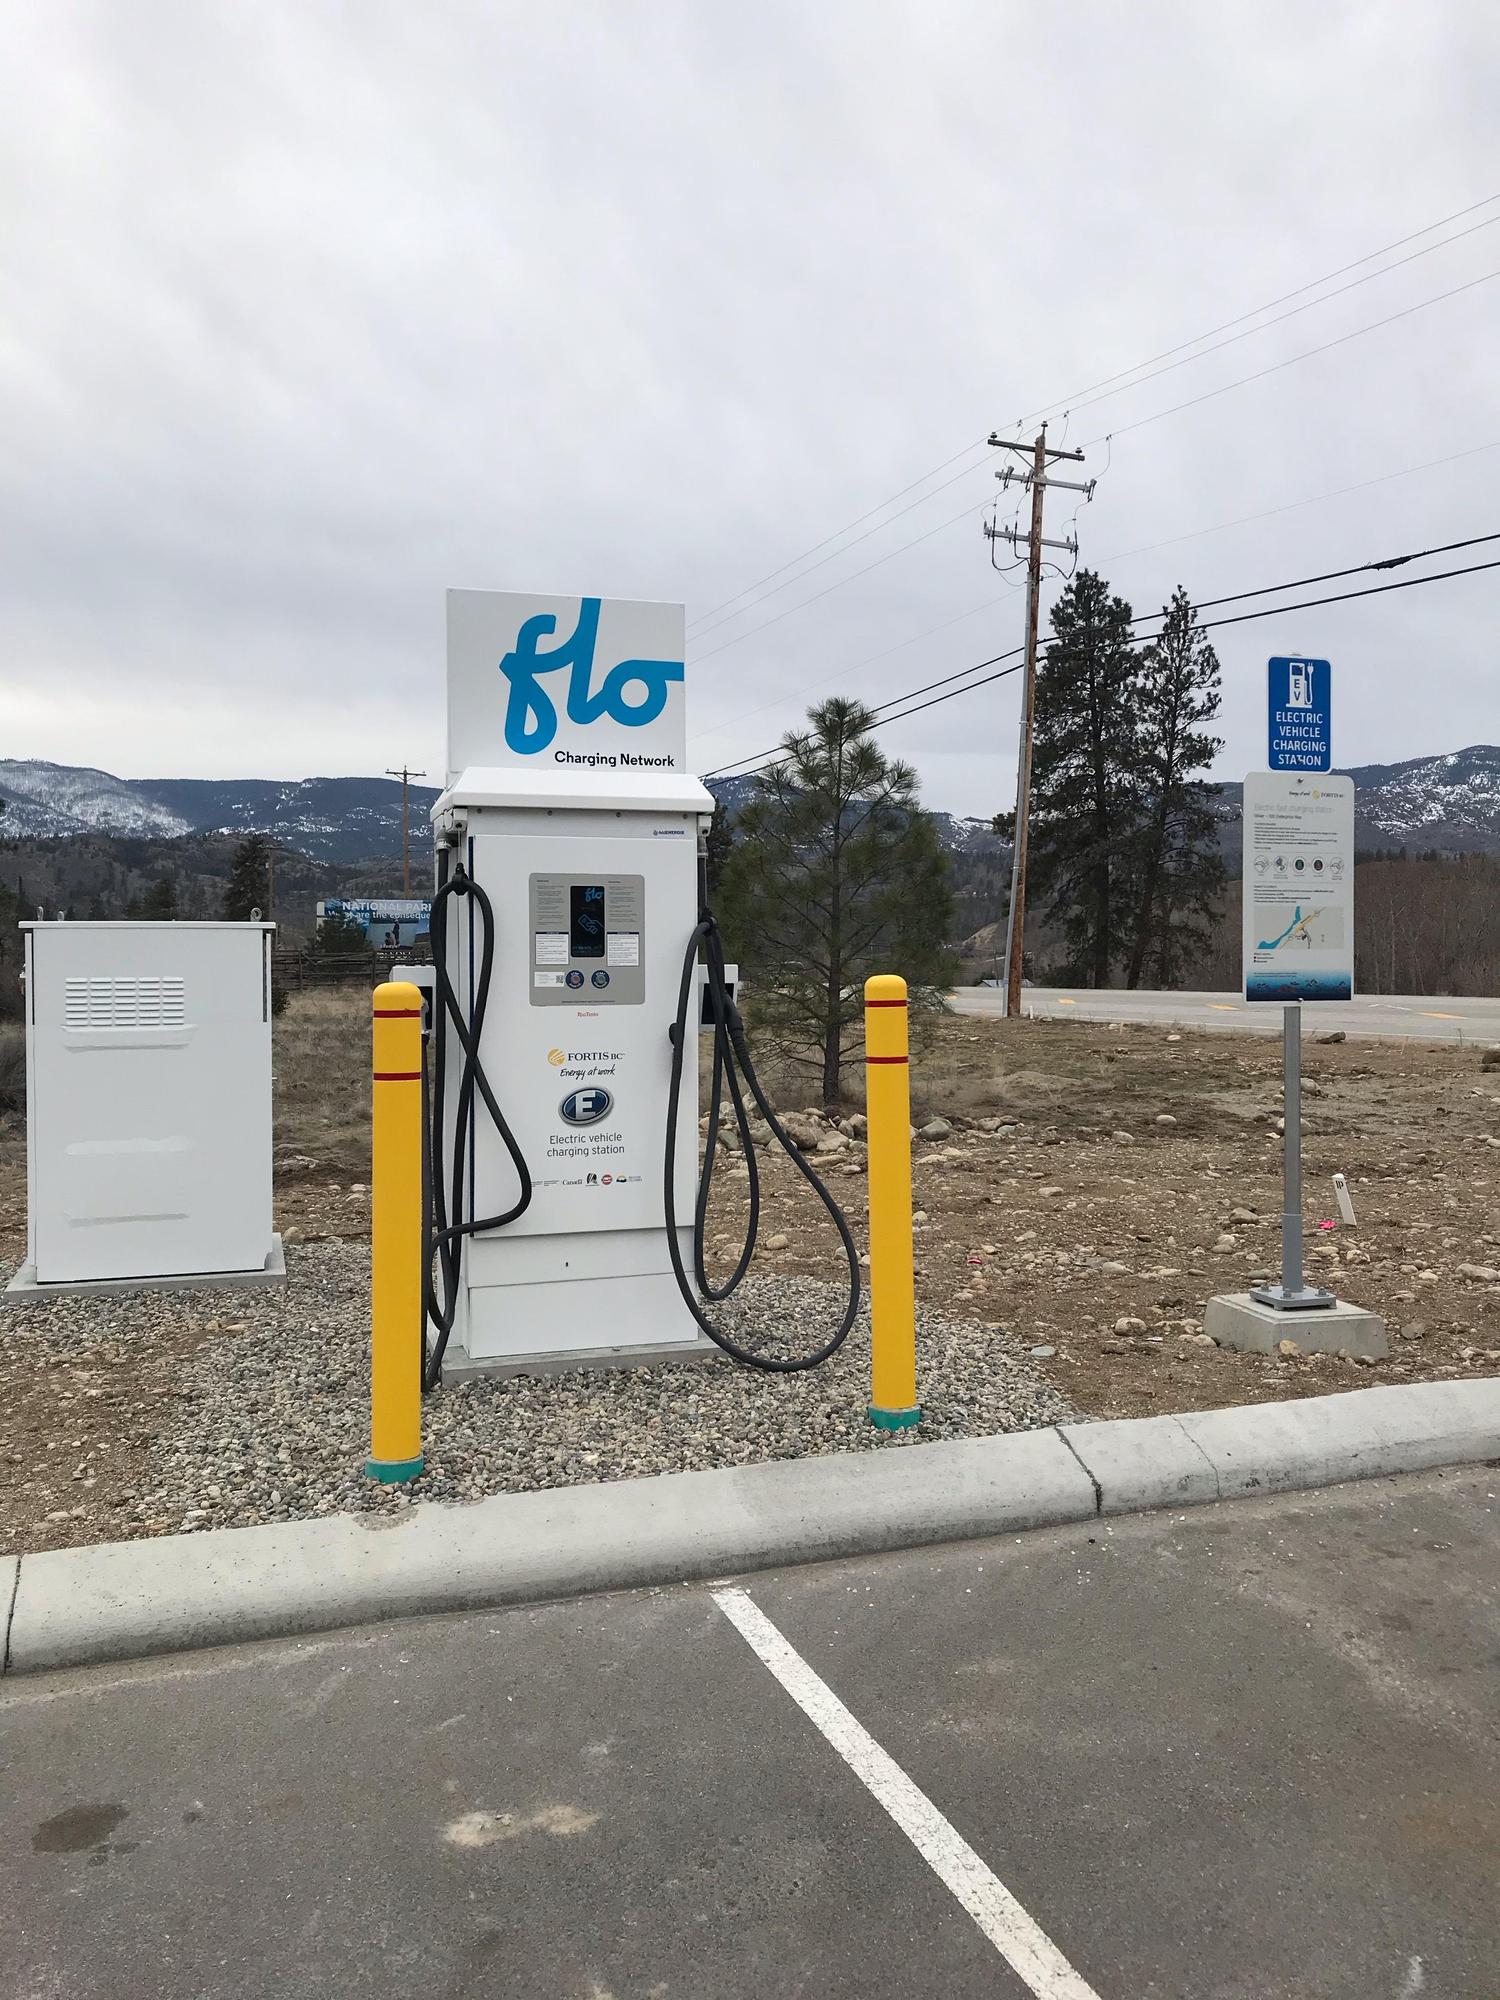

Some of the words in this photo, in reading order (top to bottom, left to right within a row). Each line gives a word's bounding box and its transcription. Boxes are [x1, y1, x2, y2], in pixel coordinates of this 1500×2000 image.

[499, 597, 684, 755] flo
[1276, 711, 1324, 724] ELECTRIC
[1279, 726, 1321, 738] VEHICLE
[1273, 740, 1327, 752] CHARGING
[554, 750, 617, 767] Charging
[620, 753, 675, 767] Network
[342, 901, 401, 911] NATIONAL
[373, 911, 387, 919] the
[568, 1052, 609, 1061] FORTIS
[560, 1068, 587, 1080] Energy
[587, 1066, 597, 1076] at
[597, 1064, 616, 1076] work
[549, 1134, 586, 1145] Electric
[588, 1132, 622, 1143] vehicle
[547, 1146, 589, 1158] charging
[591, 1144, 625, 1155] station
